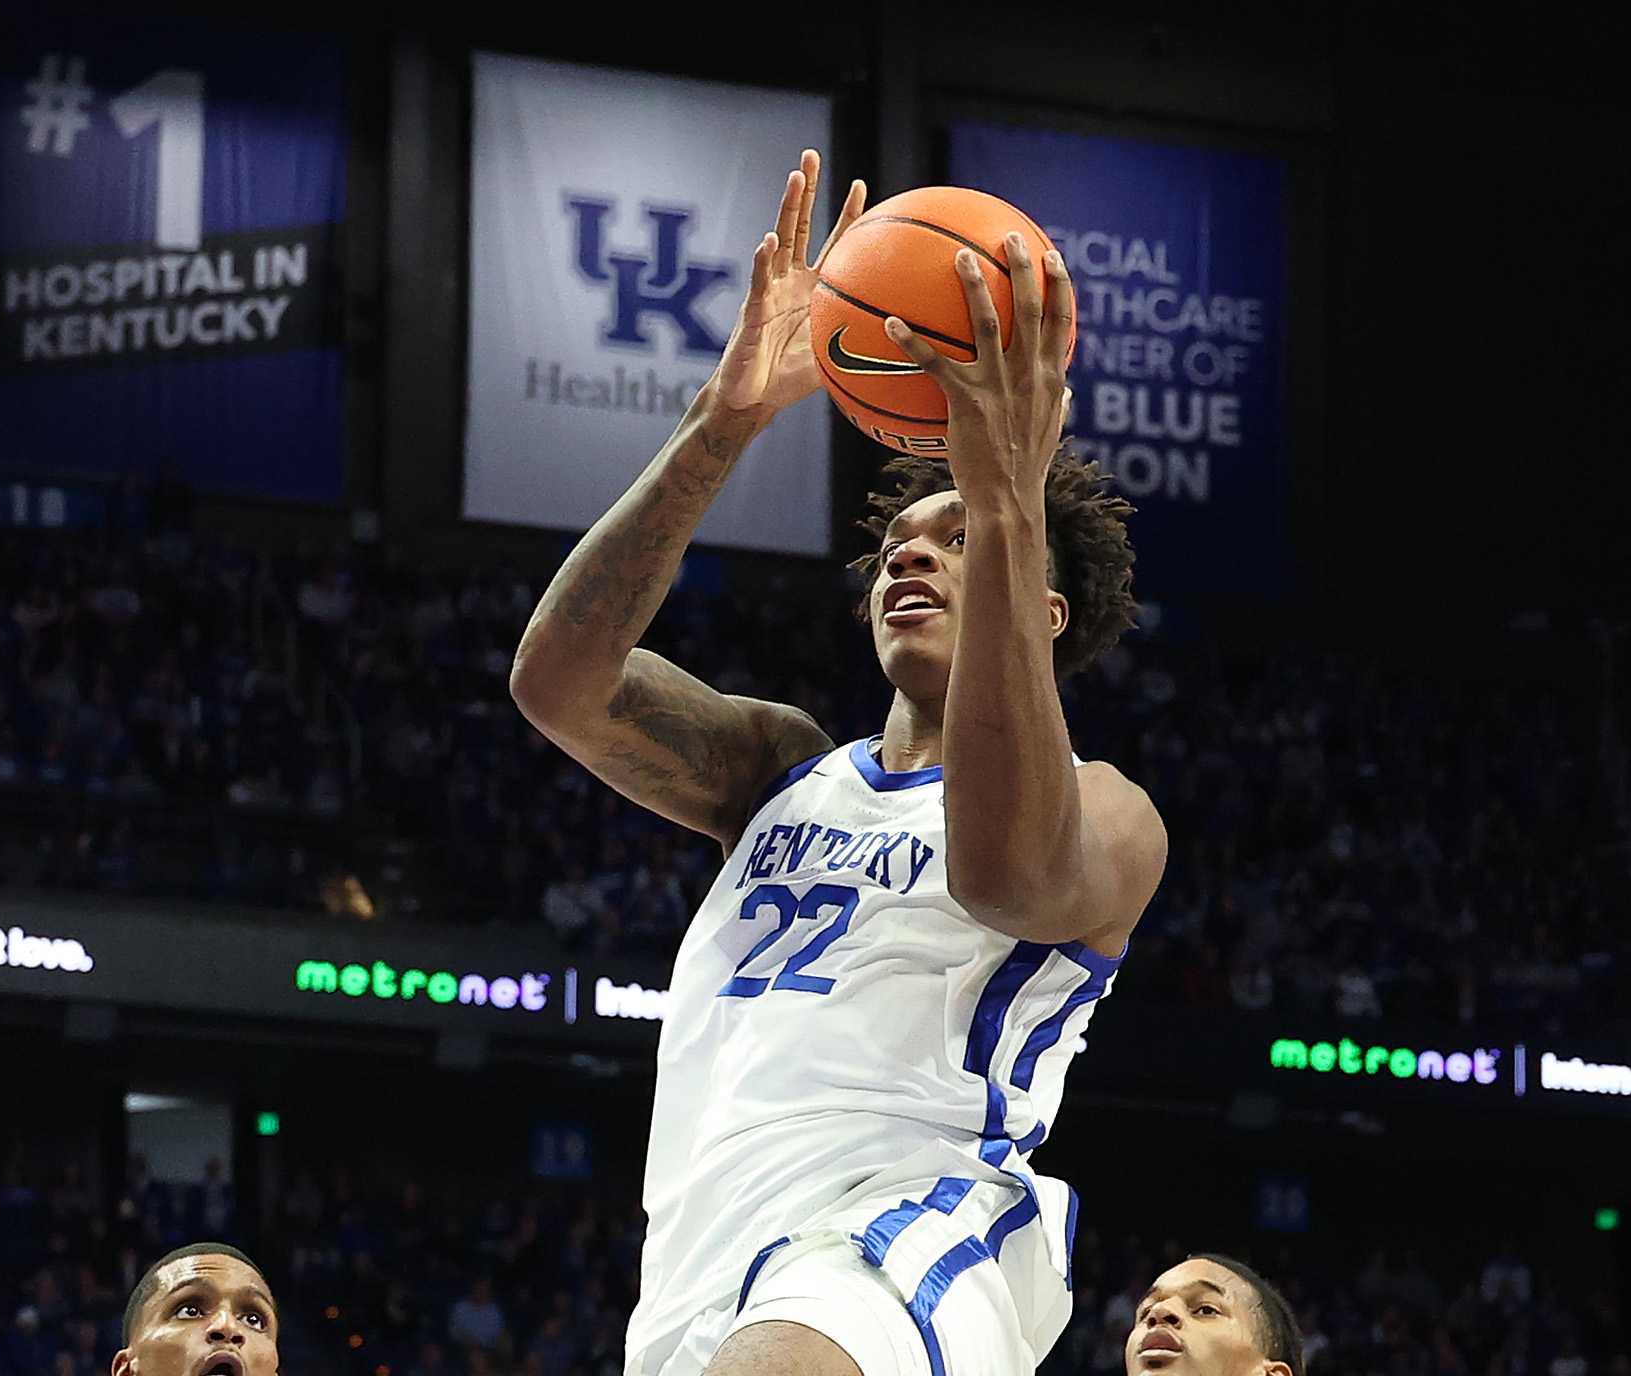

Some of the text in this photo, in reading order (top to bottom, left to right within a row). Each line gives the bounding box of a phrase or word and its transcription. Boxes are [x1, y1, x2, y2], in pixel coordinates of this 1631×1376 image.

[4, 243, 307, 310] HOSPITAL IN
[562, 189, 738, 357] UK
[23, 296, 292, 362] KENTUCKY
[1182, 338, 1251, 386] OF
[1092, 380, 1244, 446] BLUE
[735, 822, 935, 894] KENTUCKY
[715, 884, 861, 998] 22
[296, 959, 547, 1012] metronet
[1270, 1036, 1499, 1086] metronet
